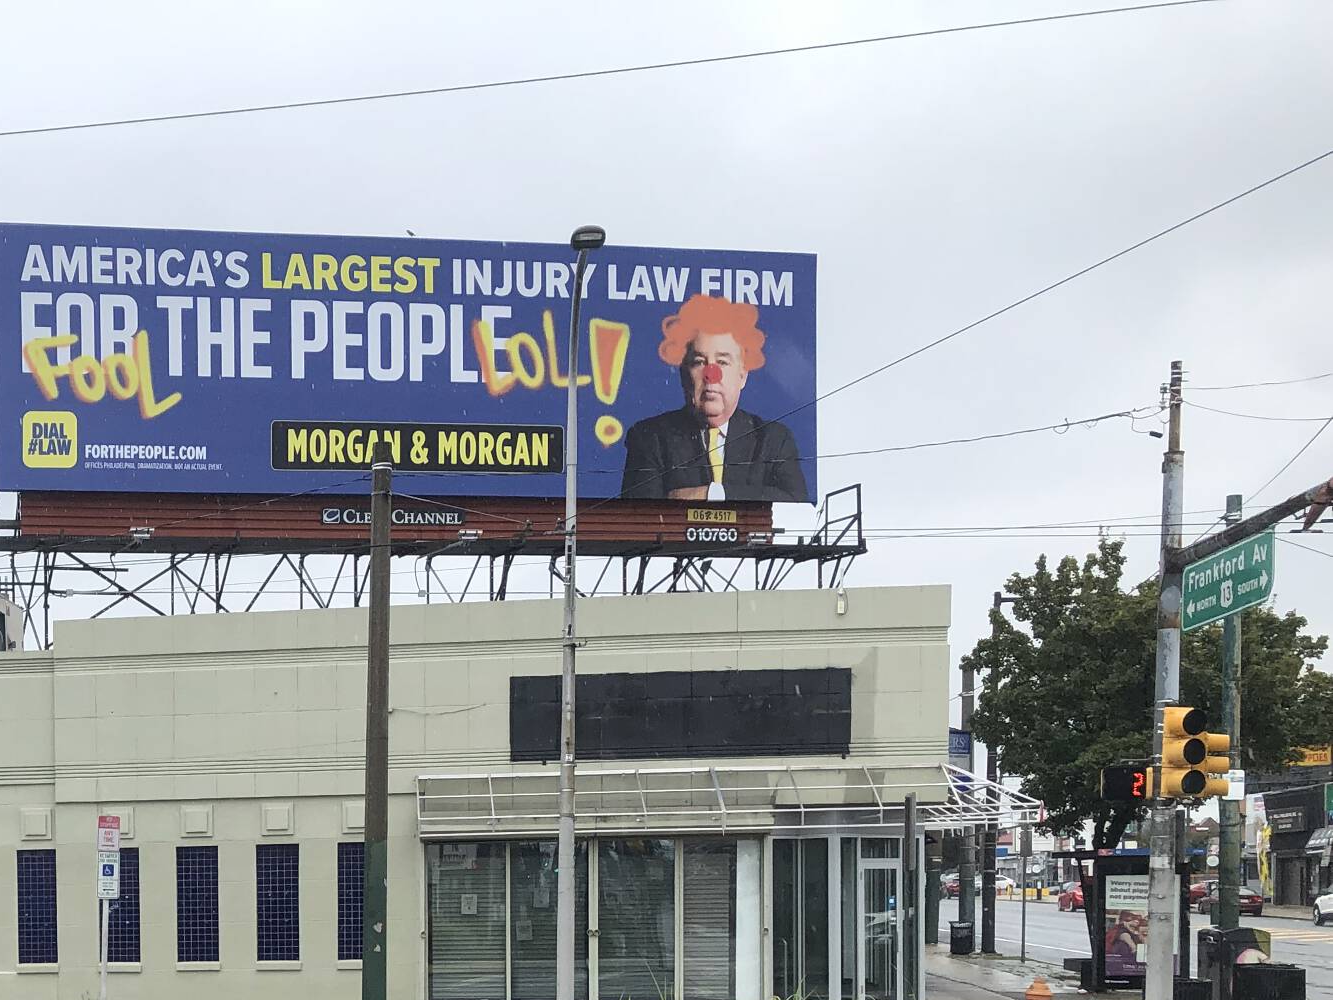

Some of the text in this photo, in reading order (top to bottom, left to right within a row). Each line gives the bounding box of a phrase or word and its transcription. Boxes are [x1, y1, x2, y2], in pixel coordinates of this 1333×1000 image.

[20, 243, 794, 306] AMERICA'S LARGEST INJURY LAW FIRM
[20, 291, 513, 384] FOR THE PEOPLE
[32, 422, 68, 439] DIAL
[28, 439, 72, 456] #LAW
[84, 444, 207, 461] FORTHEPEOPLE.COM
[288, 428, 549, 466] MORGAN & MORGAN
[686, 527, 738, 542] 010760
[1188, 543, 1268, 592] Frankford Av
[1222, 585, 1231, 602] 13
[1237, 578, 1258, 595] SOUTH
[1196, 595, 1217, 611] NORTH
